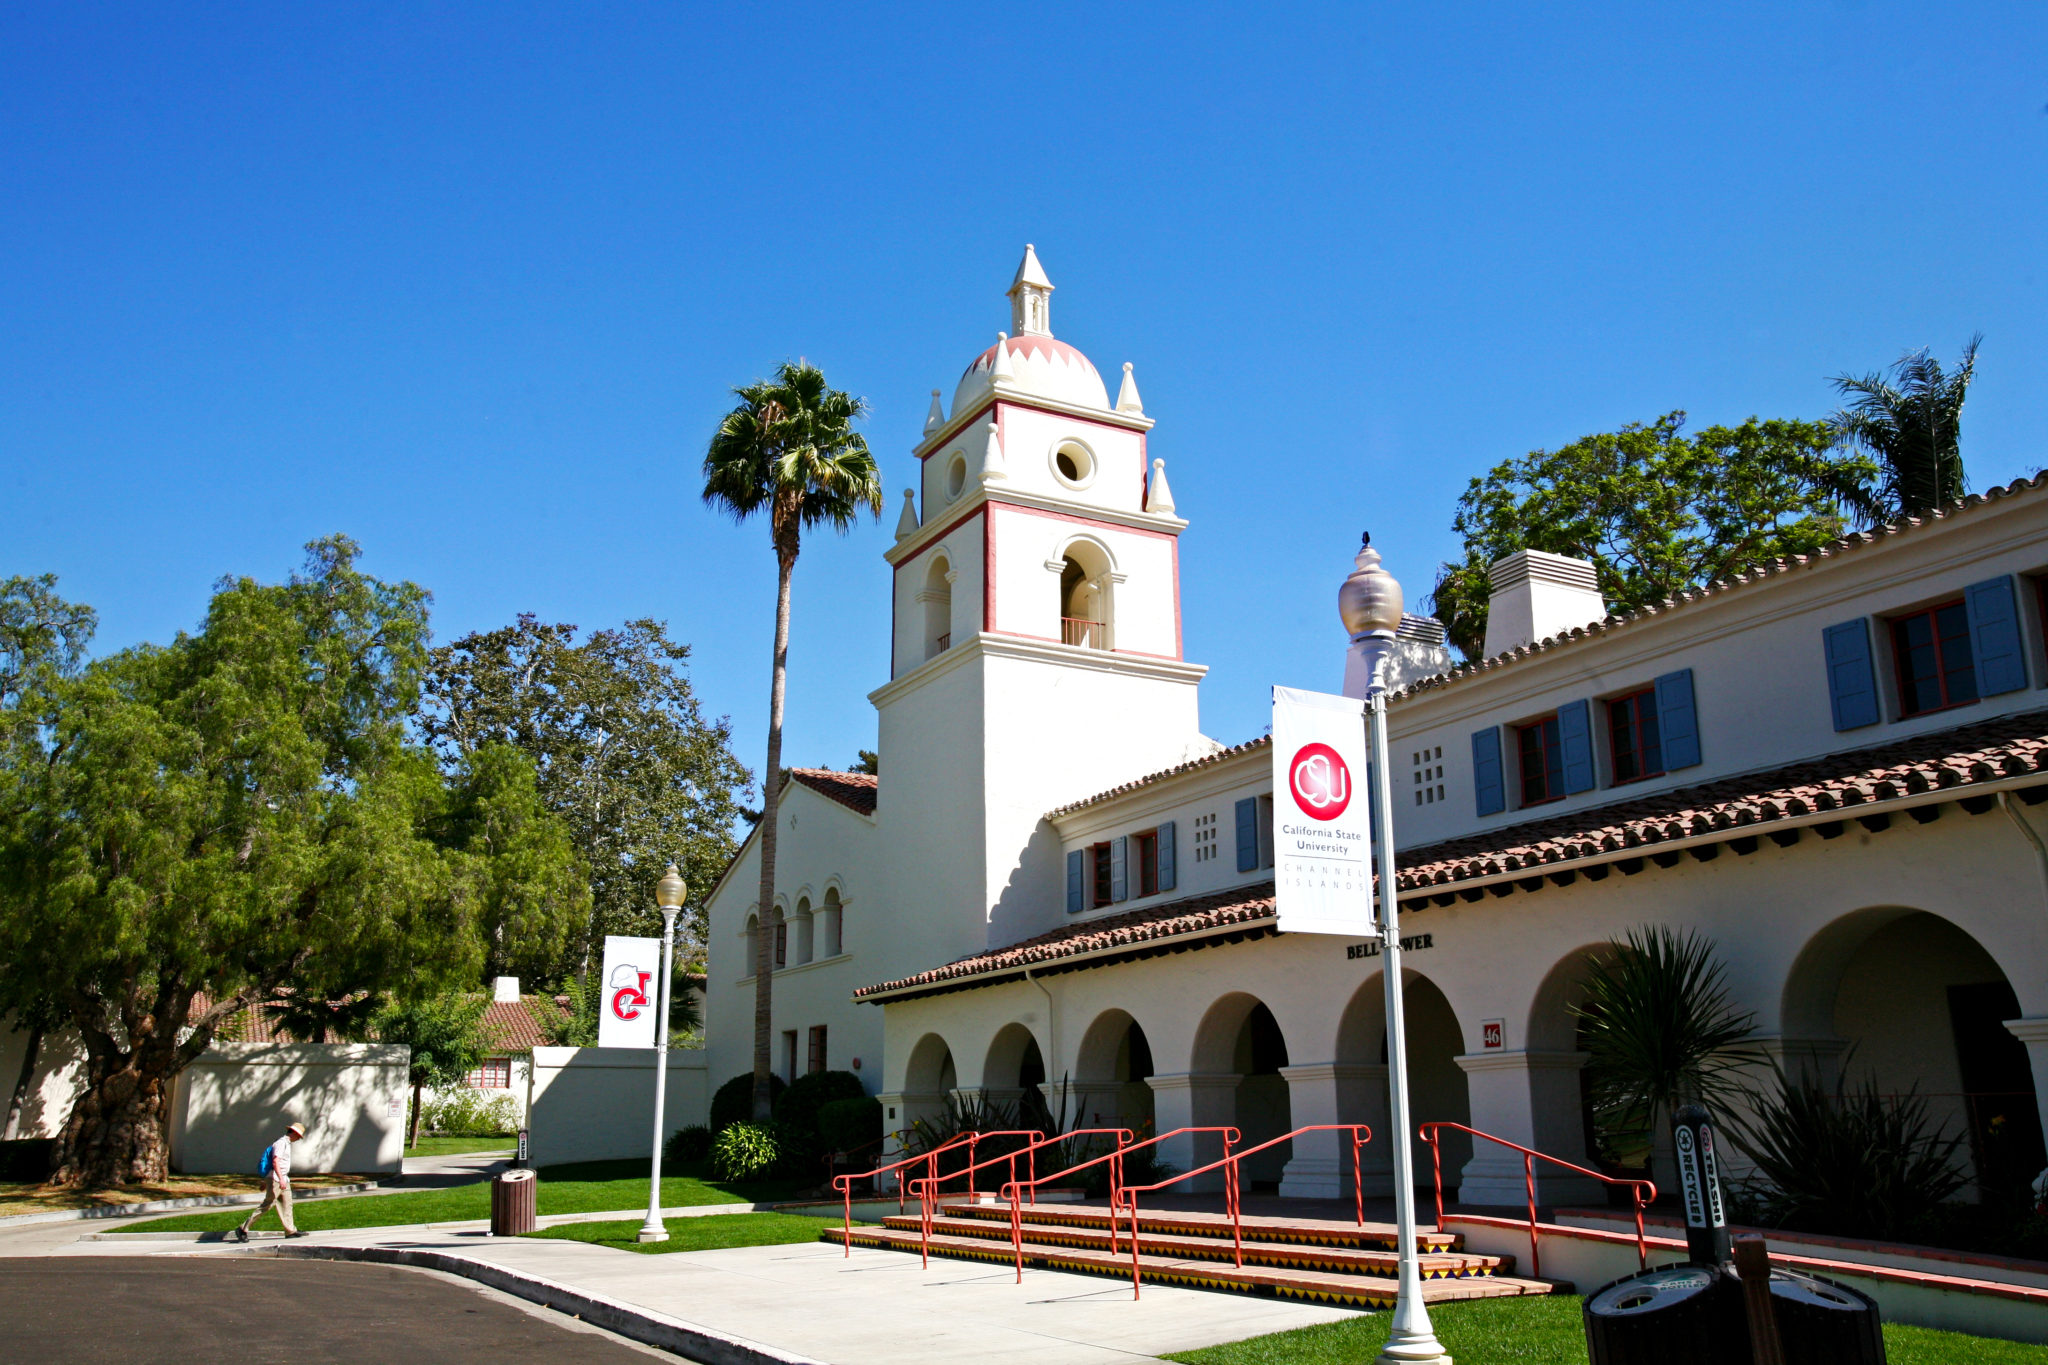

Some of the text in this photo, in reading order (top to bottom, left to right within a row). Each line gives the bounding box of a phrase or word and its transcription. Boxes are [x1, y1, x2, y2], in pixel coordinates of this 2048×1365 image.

[1294, 754, 1346, 808] CSU
[1282, 824, 1361, 841] California State
[1297, 839, 1348, 856] University
[1284, 863, 1362, 877] CHANNEL
[1286, 877, 1363, 891] ISLANDS
[1346, 933, 1433, 960] BELL WER
[1484, 1028, 1500, 1044] 46
[1683, 1154, 1701, 1214] RECYCLE
[1705, 1153, 1719, 1213] TRASH
